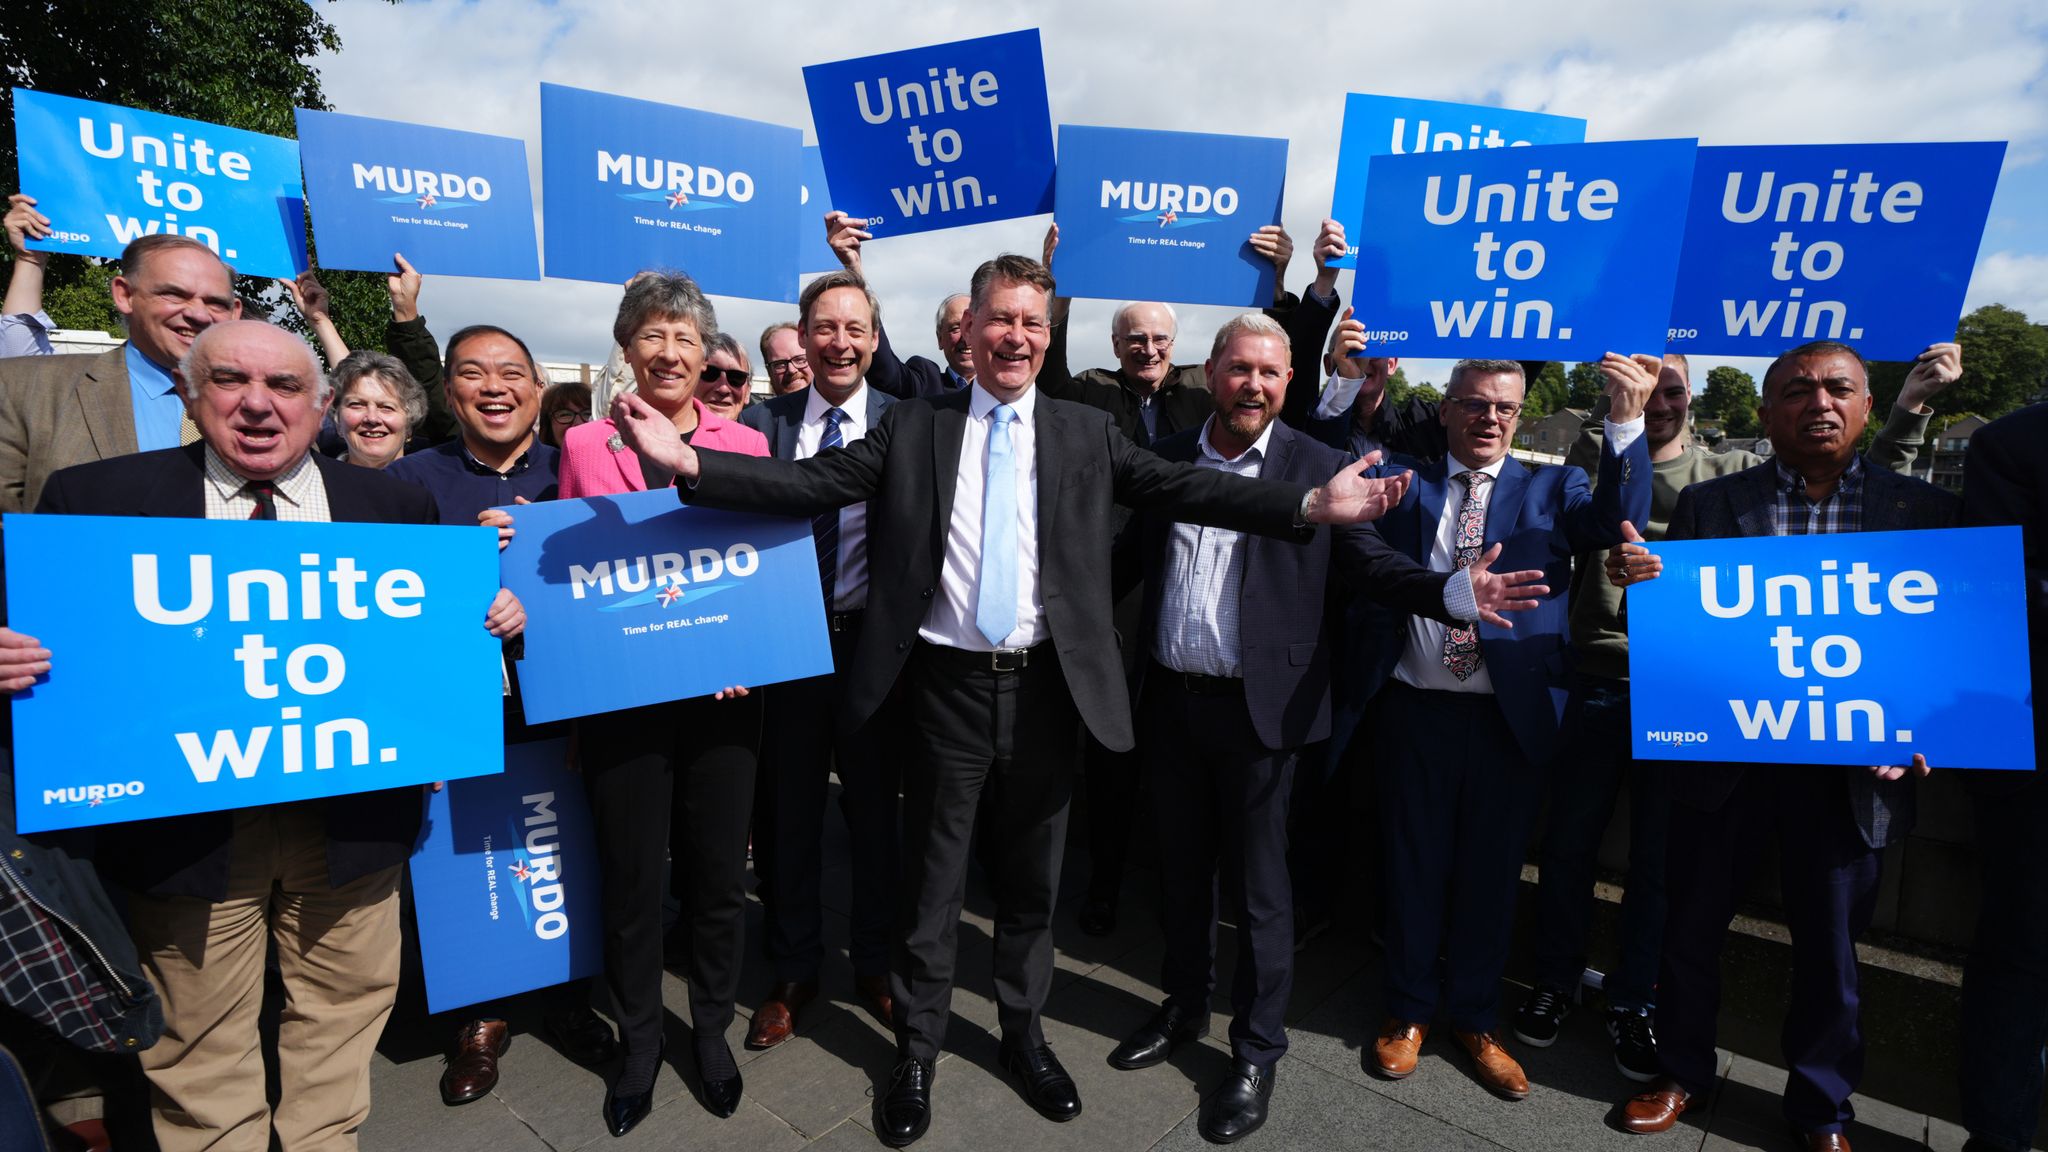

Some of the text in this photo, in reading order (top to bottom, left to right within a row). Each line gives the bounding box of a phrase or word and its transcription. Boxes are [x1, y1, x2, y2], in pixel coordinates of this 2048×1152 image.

[855, 68, 998, 124] Unite
[80, 118, 251, 180] Unite
[907, 126, 962, 166] to
[1392, 118, 1531, 154] Unit
[137, 170, 203, 211] to
[353, 164, 491, 201] MURDO
[598, 151, 754, 202] MURDO
[891, 170, 997, 217] win.
[1101, 180, 1238, 215] MURDO
[1424, 170, 1618, 225] Unite
[1722, 170, 1923, 223] Unite
[47, 230, 91, 243] URDO
[105, 213, 237, 258] win.
[391, 215, 409, 223] Time
[423, 218, 442, 226] REAL
[443, 220, 468, 229] change
[633, 216, 721, 235] Time for REAL change
[1128, 236, 1145, 244] Time
[1159, 238, 1178, 246] REAL
[1179, 239, 1205, 248] change
[1474, 232, 1545, 280] to
[1771, 232, 1844, 280] to
[1430, 288, 1572, 339] win.
[1667, 328, 1698, 339] RDO
[1723, 288, 1863, 339] win.
[132, 553, 425, 625] Unite
[569, 543, 760, 599] MURDO
[1700, 560, 1938, 618] Unite
[622, 613, 728, 635] Time for REAL change
[234, 634, 345, 699] to
[1771, 626, 1861, 678] to
[1647, 731, 1709, 743] MURDO
[1729, 686, 1912, 742] win.
[175, 706, 397, 782] win.
[44, 781, 144, 804] MURDO
[483, 834, 499, 920] Time for REAL change
[522, 791, 569, 940] MURDO
